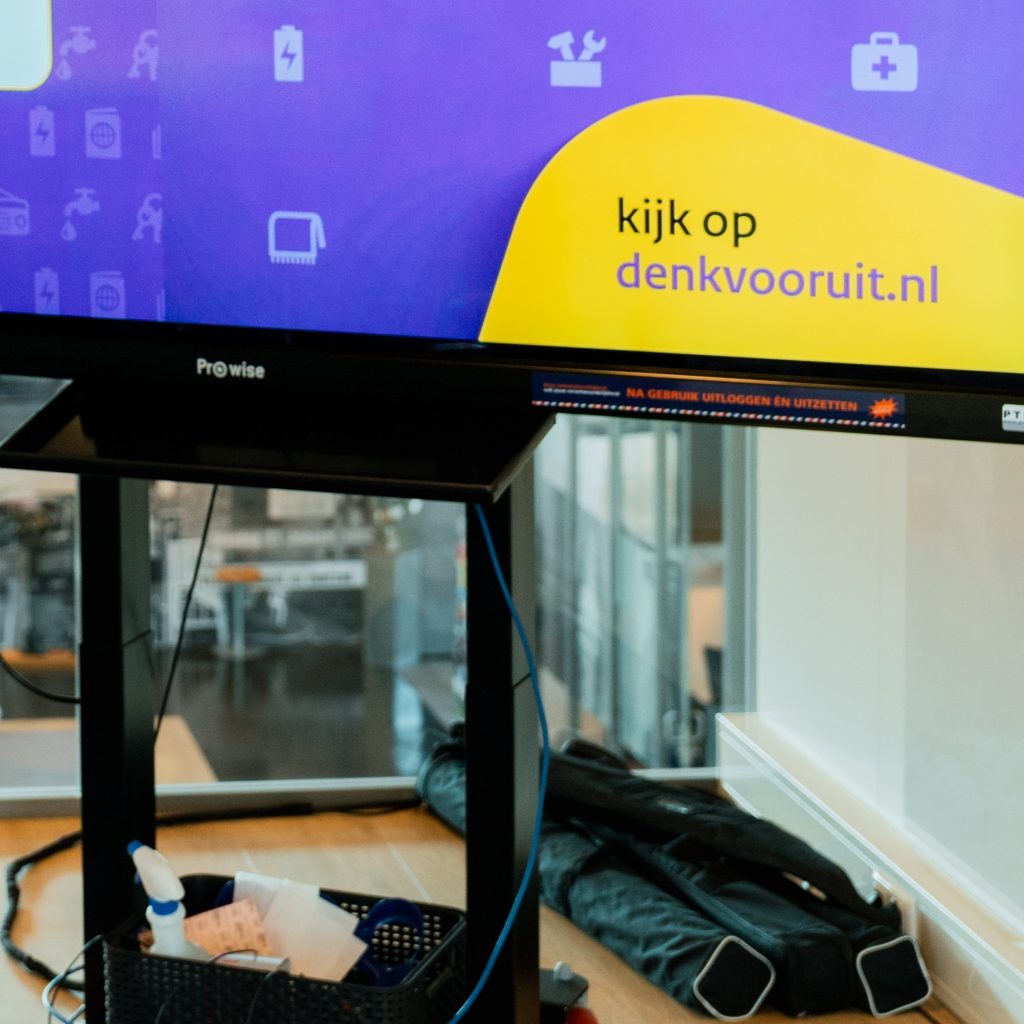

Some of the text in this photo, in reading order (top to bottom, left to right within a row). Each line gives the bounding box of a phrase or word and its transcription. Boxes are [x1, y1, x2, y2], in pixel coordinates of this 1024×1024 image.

[618, 197, 757, 248] kijk op
[616, 252, 938, 304] denkvooruit.nl
[196, 358, 266, 380] Prowise
[626, 387, 644, 399] NA
[647, 389, 699, 403] GEBRUIK
[702, 392, 771, 407] UITLOGGEN
[774, 393, 791, 408] ÉN
[794, 396, 858, 412] UITZETTEN
